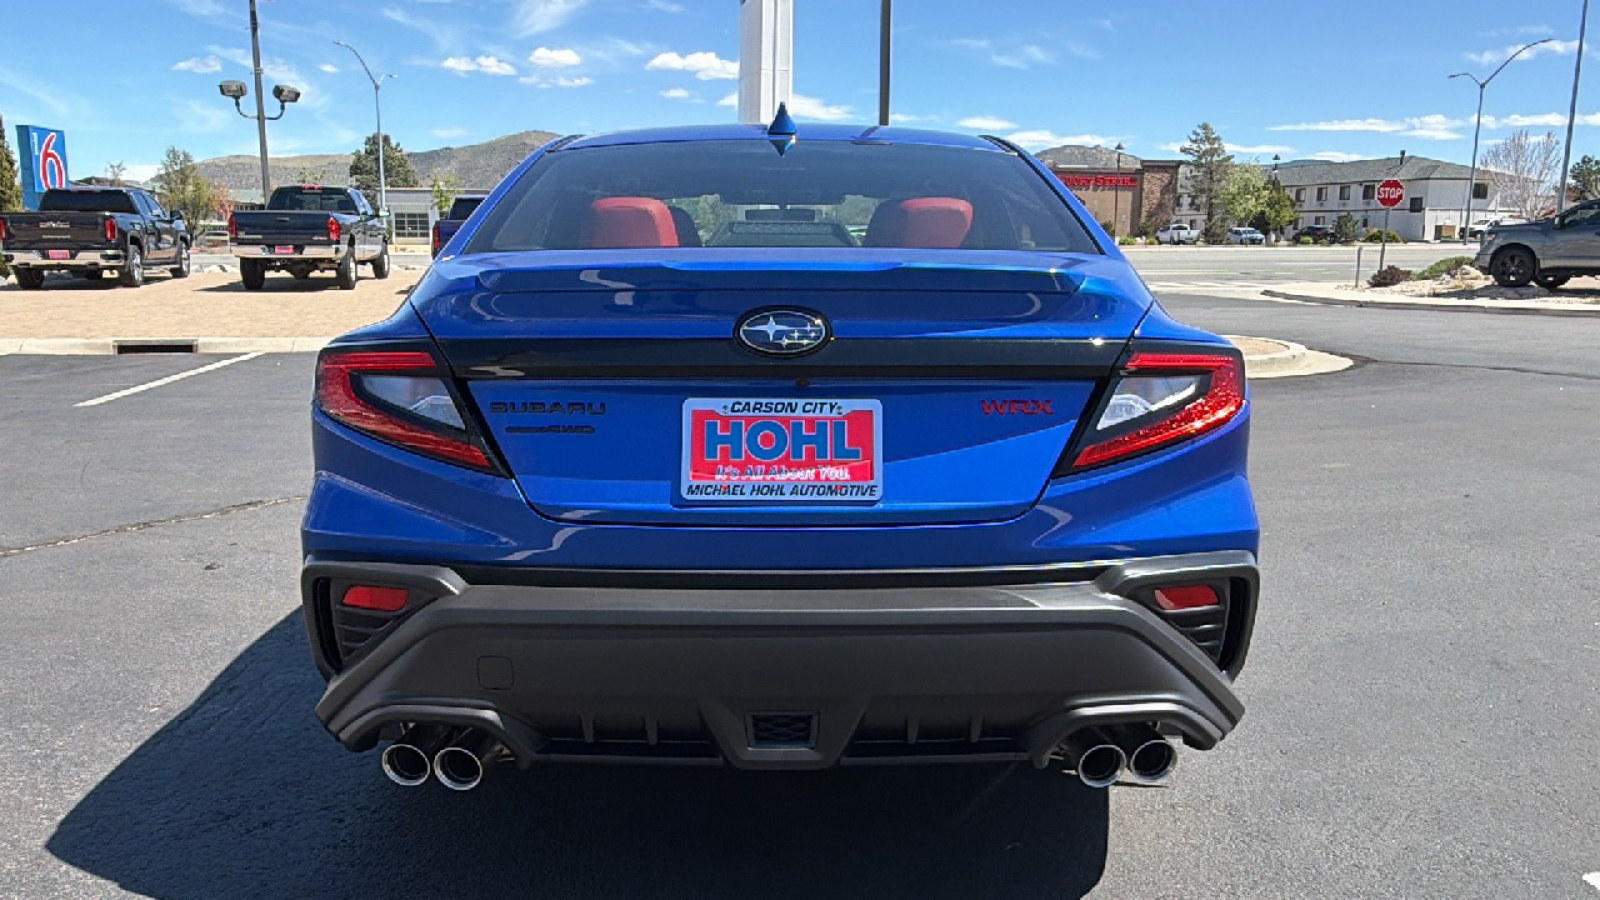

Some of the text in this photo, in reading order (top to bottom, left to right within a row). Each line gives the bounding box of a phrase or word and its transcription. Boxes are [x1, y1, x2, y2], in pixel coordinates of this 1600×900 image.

[40, 132, 65, 190] 6
[1378, 187, 1402, 199] STOP
[489, 401, 606, 415] SUBARU
[730, 401, 838, 414] CARSON CITY
[980, 399, 1054, 415] WRX
[704, 419, 862, 461] HOHL
[715, 465, 741, 480] It's
[741, 465, 765, 480] All
[765, 466, 815, 481] About
[686, 484, 878, 497] MICHAEL HOHL AUTOMOTIVE
